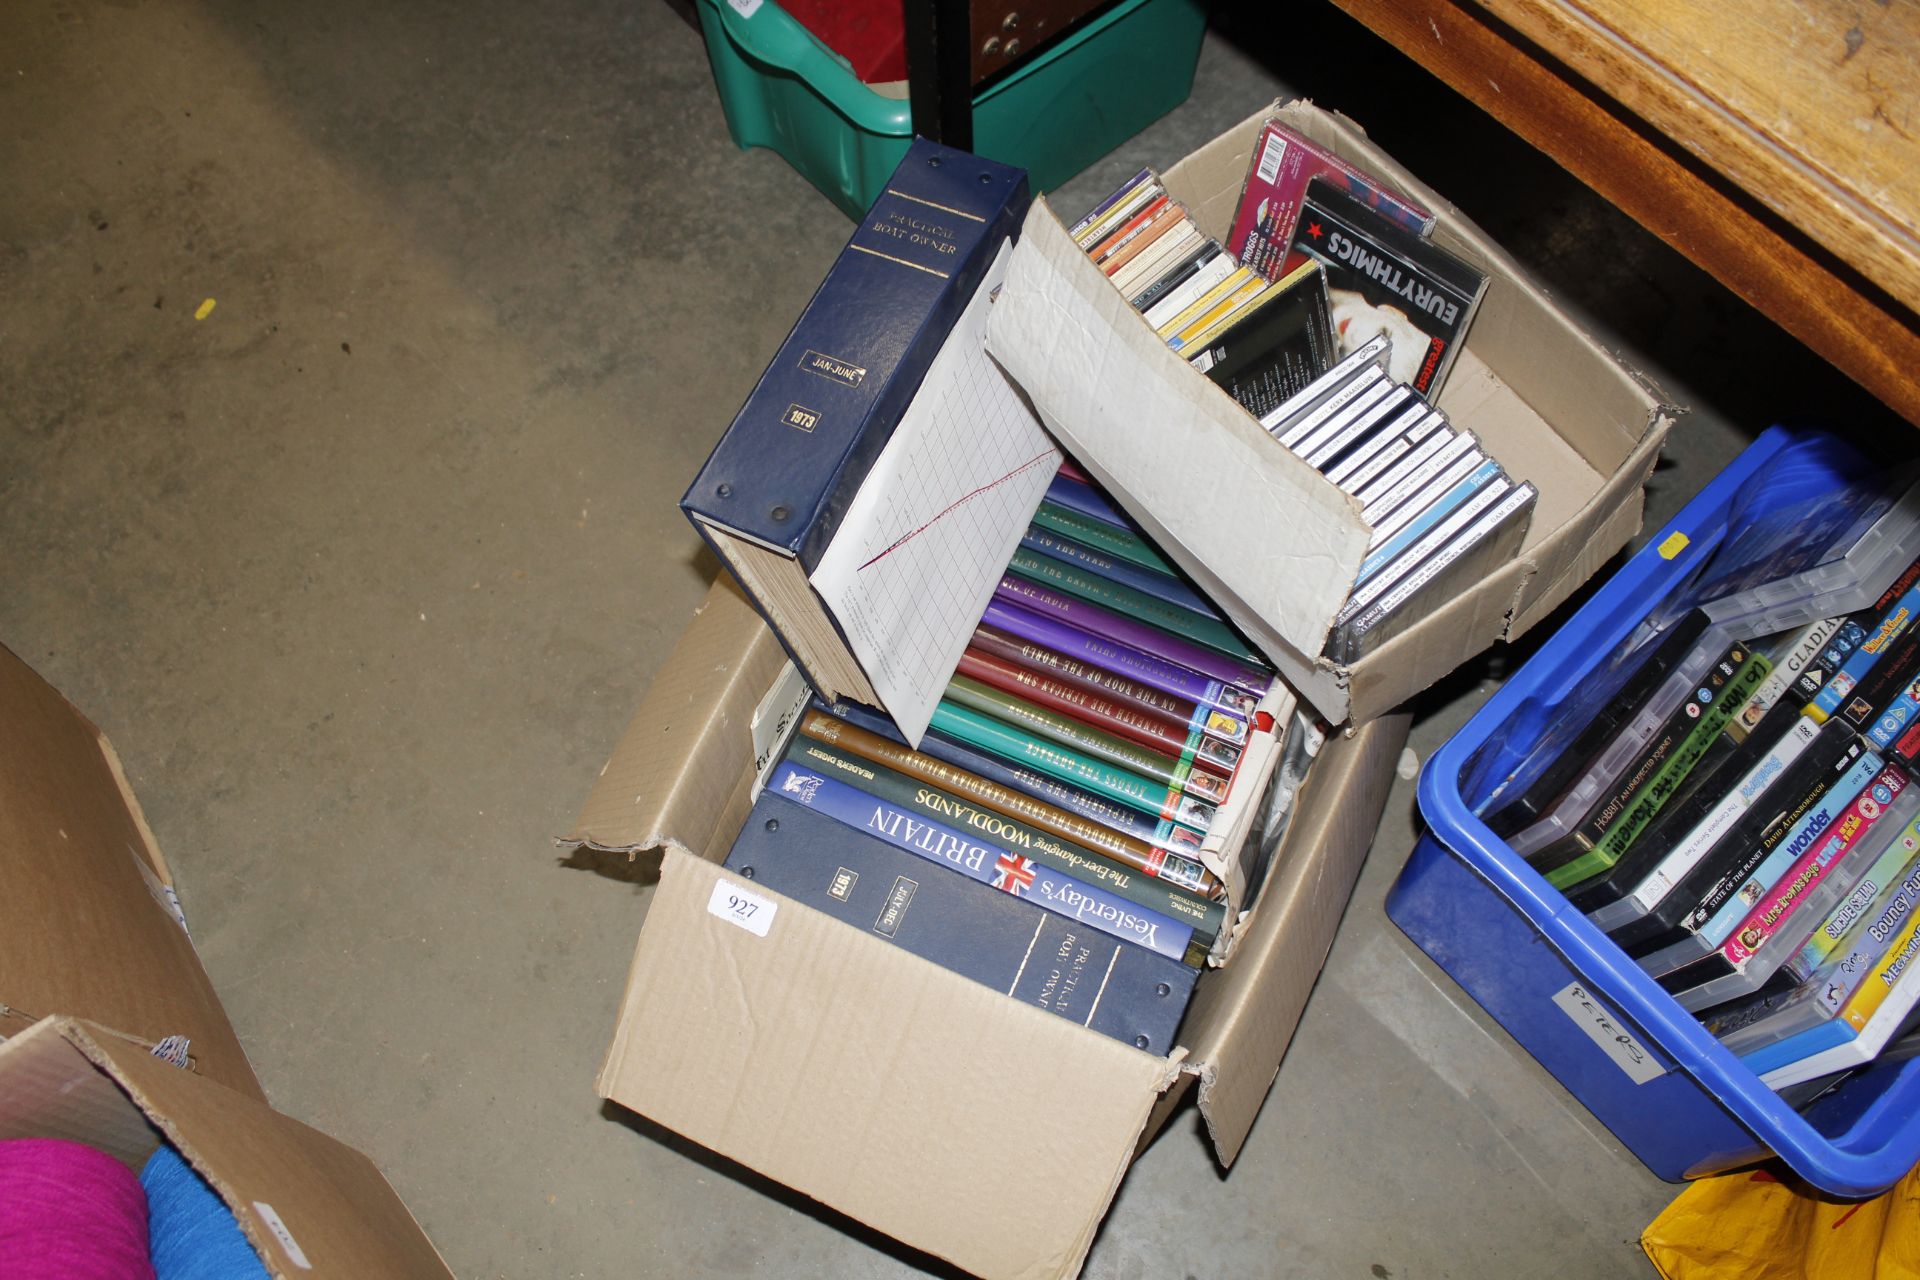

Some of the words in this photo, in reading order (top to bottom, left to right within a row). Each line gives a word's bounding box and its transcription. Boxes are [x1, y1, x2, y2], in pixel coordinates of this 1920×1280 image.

[872, 222, 907, 240] BOAT
[910, 233, 958, 255] OWNER
[889, 212, 957, 241] PRACTICAL
[1241, 230, 1259, 262] TROGGS
[1328, 232, 1458, 326] EURYTHMICS
[812, 357, 858, 381] JAN-JUNE
[1415, 337, 1446, 391] greatest
[1328, 396, 1344, 411] KERK
[790, 409, 815, 428] 1973
[1489, 508, 1507, 524] GAM
[1504, 499, 1518, 512] CD
[1354, 604, 1384, 629] GAMUT
[1784, 610, 1844, 673] GLADIA
[1019, 642, 1060, 668] WORLD
[1060, 658, 1085, 677] THE
[1015, 669, 1039, 688] SUN
[1086, 668, 1102, 684] OF
[1102, 673, 1133, 696] ROOF
[1040, 678, 1088, 706] AFRICAN
[1134, 686, 1159, 706] THE
[1159, 696, 1177, 713] ON
[1088, 697, 1113, 716] THE
[1115, 707, 1167, 737] BENEATH
[805, 745, 834, 764] DIGEST
[1023, 740, 1076, 770] OUTBACK
[832, 756, 874, 780] READER'S
[1012, 766, 1044, 788] DEEP
[1076, 760, 1102, 780] THE
[1858, 760, 1875, 776] PAL
[949, 769, 1007, 803] CANADIAN
[1044, 779, 1070, 799] THE
[1103, 770, 1148, 798] ACROSS
[1591, 795, 1627, 834] HOBBIT
[1618, 789, 1630, 801] AN
[1625, 757, 1656, 793] UNEXPECTED
[1650, 733, 1675, 761] JOURNEY
[914, 786, 1034, 849] WOODLANDS
[1008, 793, 1047, 820] GREAT
[1070, 789, 1136, 826] EXPLORING
[1724, 801, 1739, 815] The
[1048, 810, 1074, 830] THE
[1705, 809, 1729, 834] Complete
[1781, 804, 1835, 859] wonder
[865, 803, 988, 874] BRITAIN
[1075, 820, 1128, 852] THROUGH
[1692, 829, 1710, 848] Series
[1708, 888, 1728, 909] STATE
[1724, 881, 1735, 892] OF
[1730, 869, 1746, 884] THE
[1741, 848, 1765, 873] PLANET
[1762, 827, 1784, 850] DAVID
[1780, 781, 1827, 830] ATTENBOROUGH
[1030, 831, 1112, 880] Ever-changing
[1682, 844, 1696, 858] Two
[1799, 860, 1824, 885] Boys
[1812, 834, 1845, 868] LIVE
[831, 874, 851, 897] 1973
[1106, 868, 1131, 889] The
[728, 894, 759, 919] 927
[884, 886, 908, 925] JULY-DEC
[1035, 870, 1167, 949] Yesterday's
[1167, 890, 1208, 913] COUNTRYSIDE
[1170, 900, 1192, 914] LIVING
[1191, 908, 1205, 919] THE
[1823, 903, 1859, 940] SUICIDE
[1847, 878, 1881, 913] SQUAD
[1868, 893, 1911, 943] Bouncy
[1054, 932, 1076, 965] BOAT
[1569, 982, 1647, 1067] PETERS
